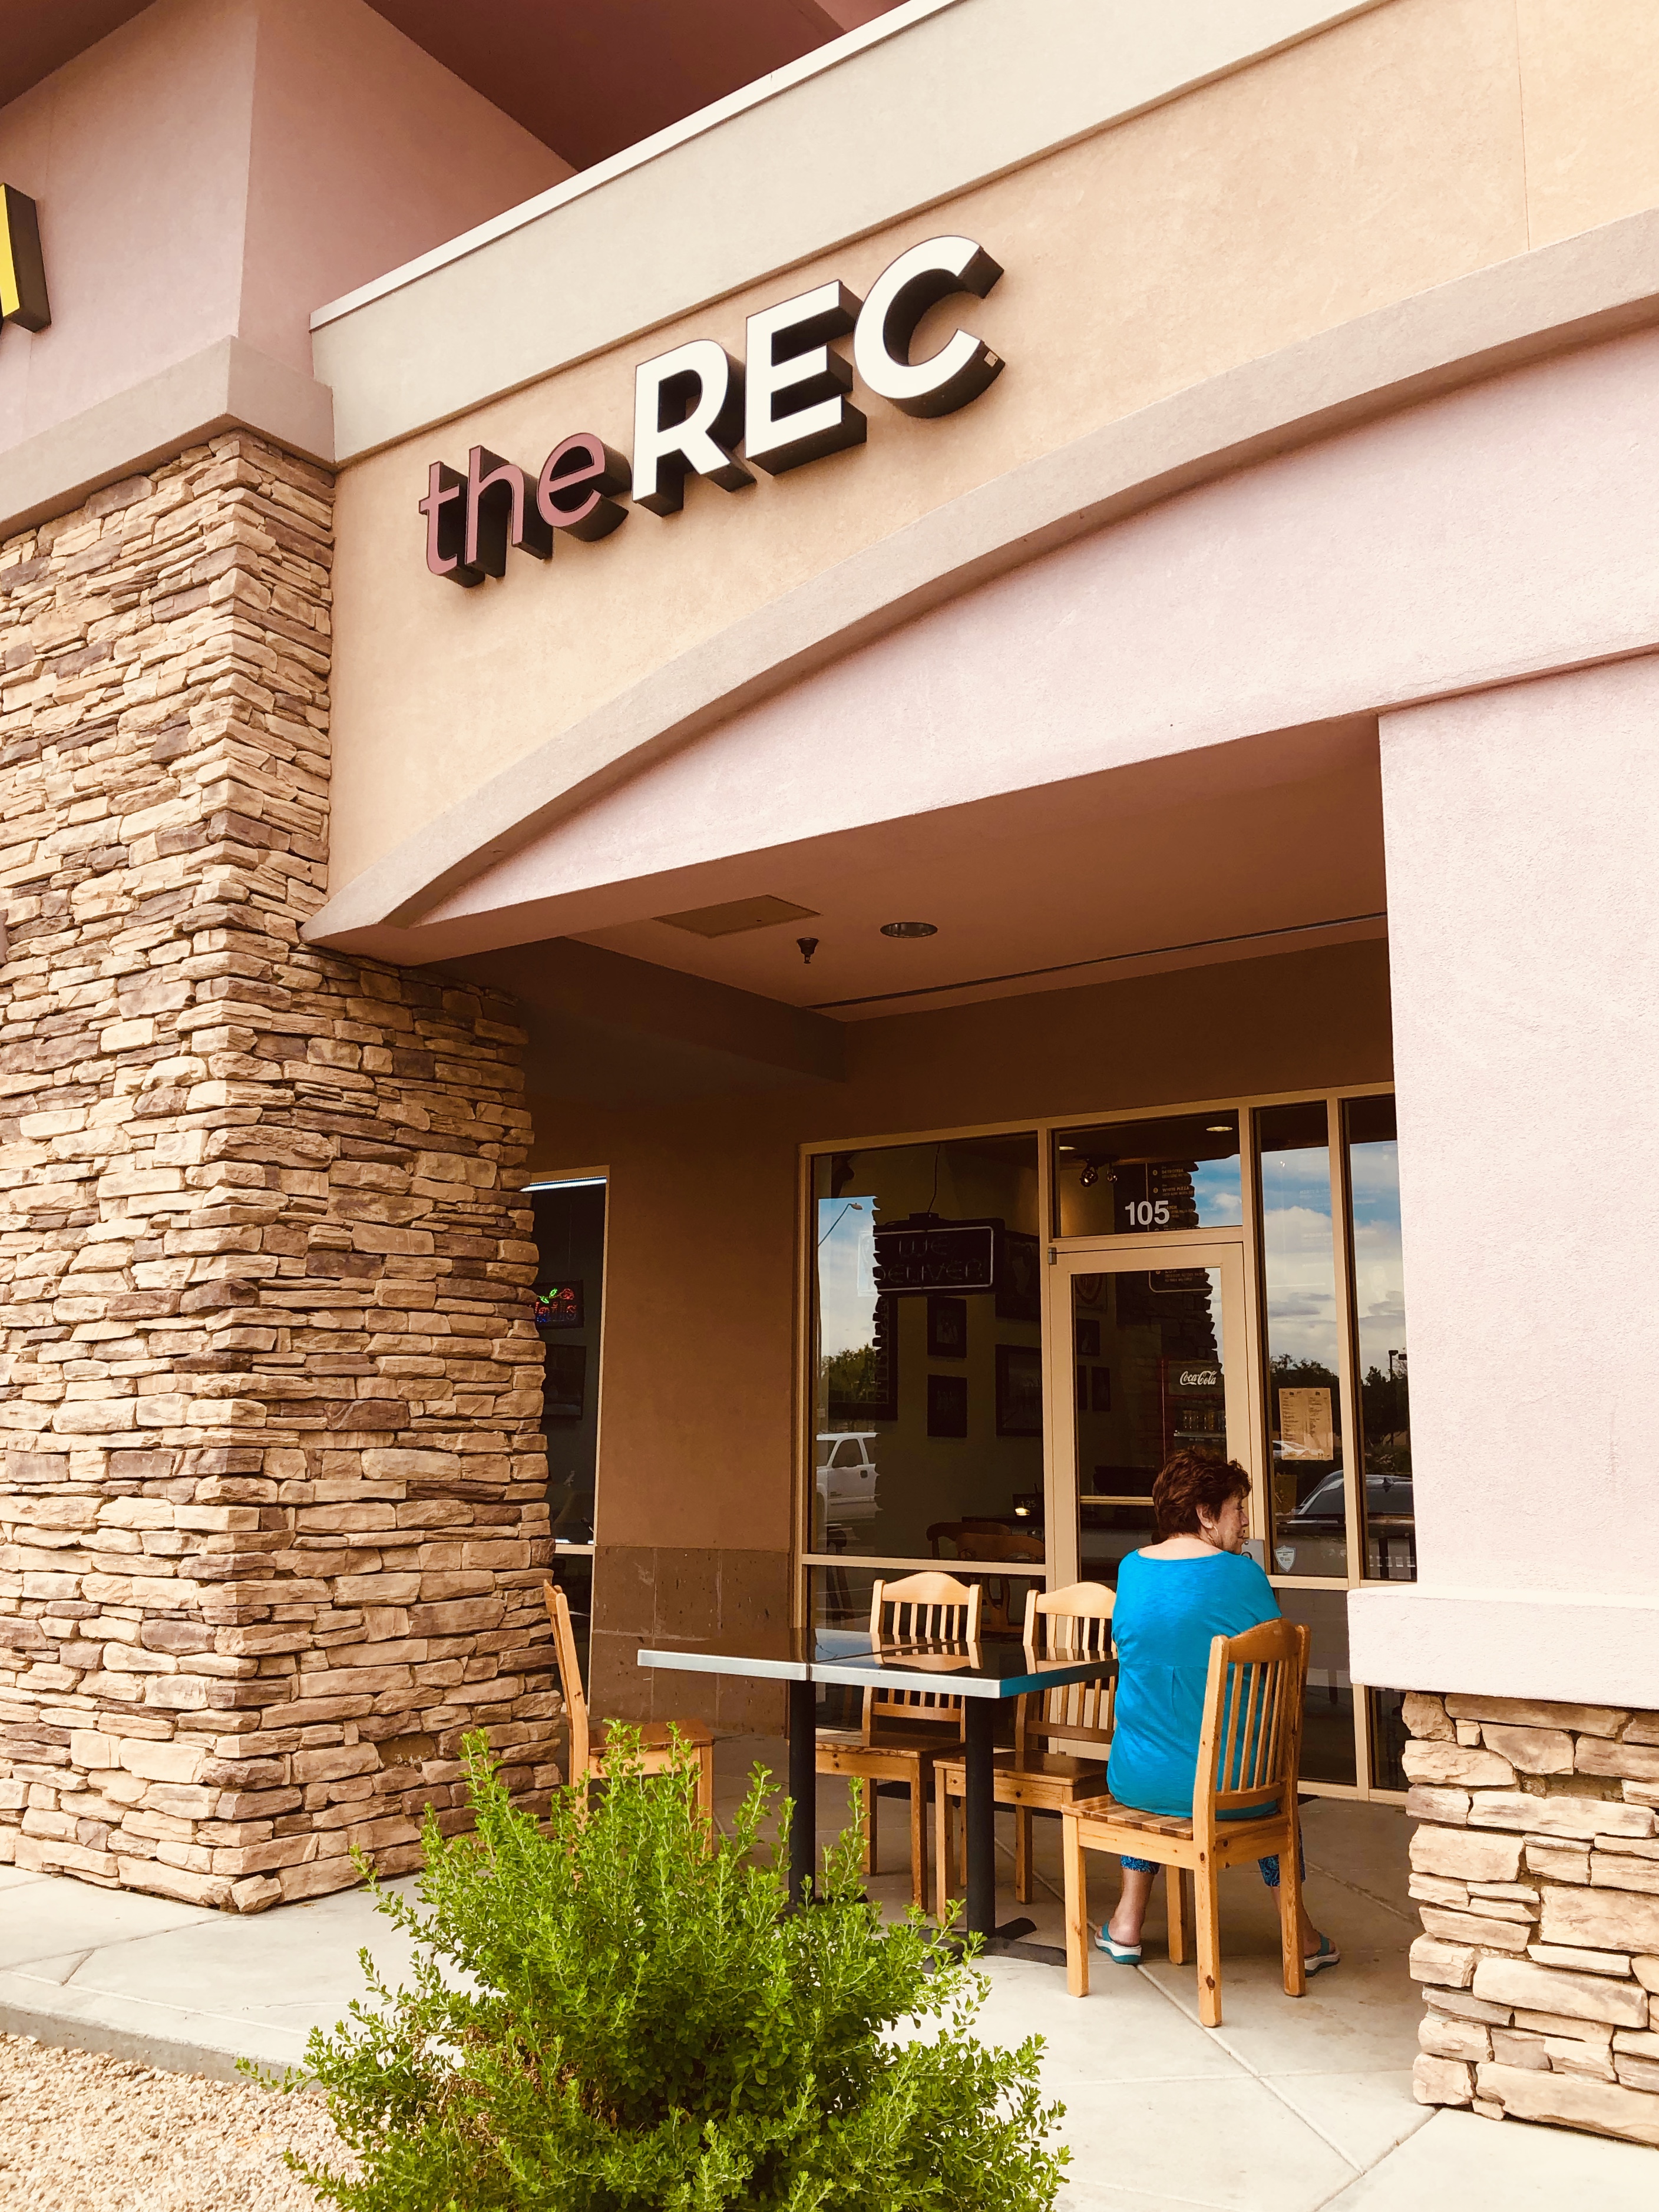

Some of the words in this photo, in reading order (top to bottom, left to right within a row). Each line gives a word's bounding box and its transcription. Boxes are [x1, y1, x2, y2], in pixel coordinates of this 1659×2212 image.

[419, 432, 606, 576] the
[632, 235, 983, 502] REC
[1125, 1200, 1170, 1225] 105
